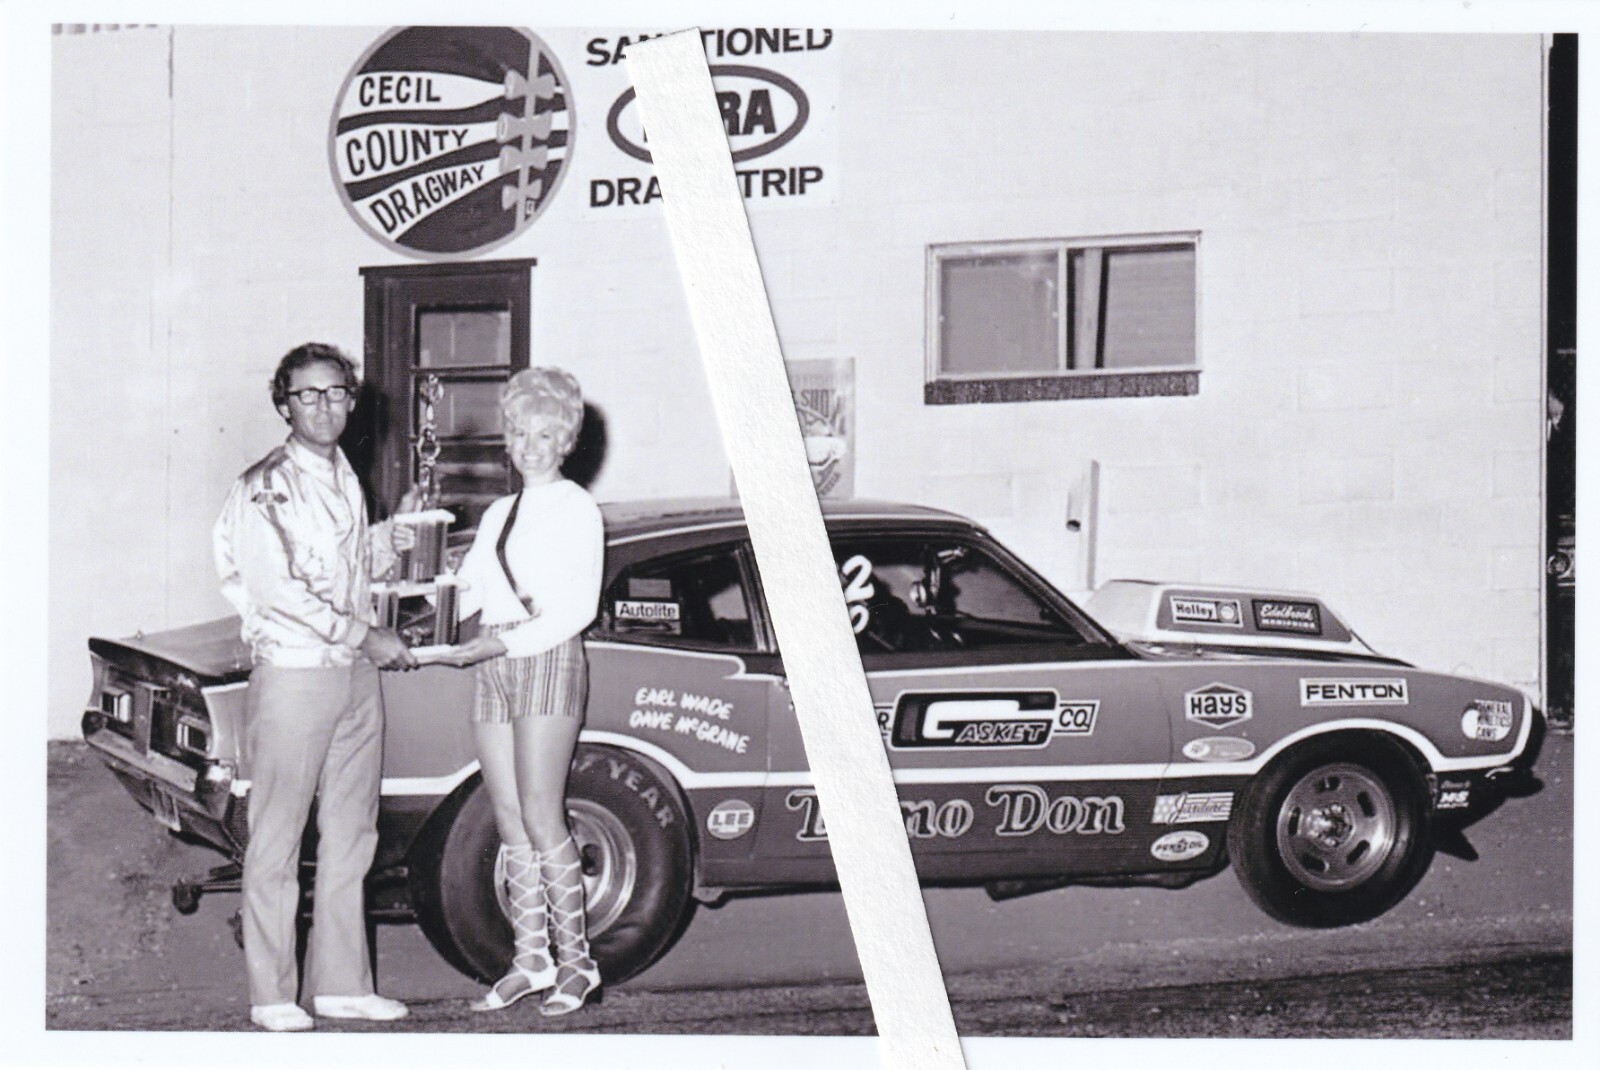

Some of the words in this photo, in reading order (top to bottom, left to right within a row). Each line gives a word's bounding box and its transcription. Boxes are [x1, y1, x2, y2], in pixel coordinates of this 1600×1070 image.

[586, 28, 832, 66] SATIONED
[359, 76, 441, 106] CECIL
[346, 128, 468, 176] COUNTY
[369, 165, 484, 233] DRAGWAY
[590, 176, 664, 208] DRA
[735, 166, 824, 199] TRIP
[620, 603, 676, 618] Autolite
[1176, 603, 1213, 620] Holley
[635, 687, 677, 707] EARL
[680, 693, 734, 720] WADE
[1306, 684, 1404, 700] FENTON
[629, 710, 674, 731] DAVE
[922, 700, 1054, 743] GASKET
[608, 758, 674, 829] YEAR
[985, 784, 1126, 836] Don
[713, 812, 750, 826] LEE
